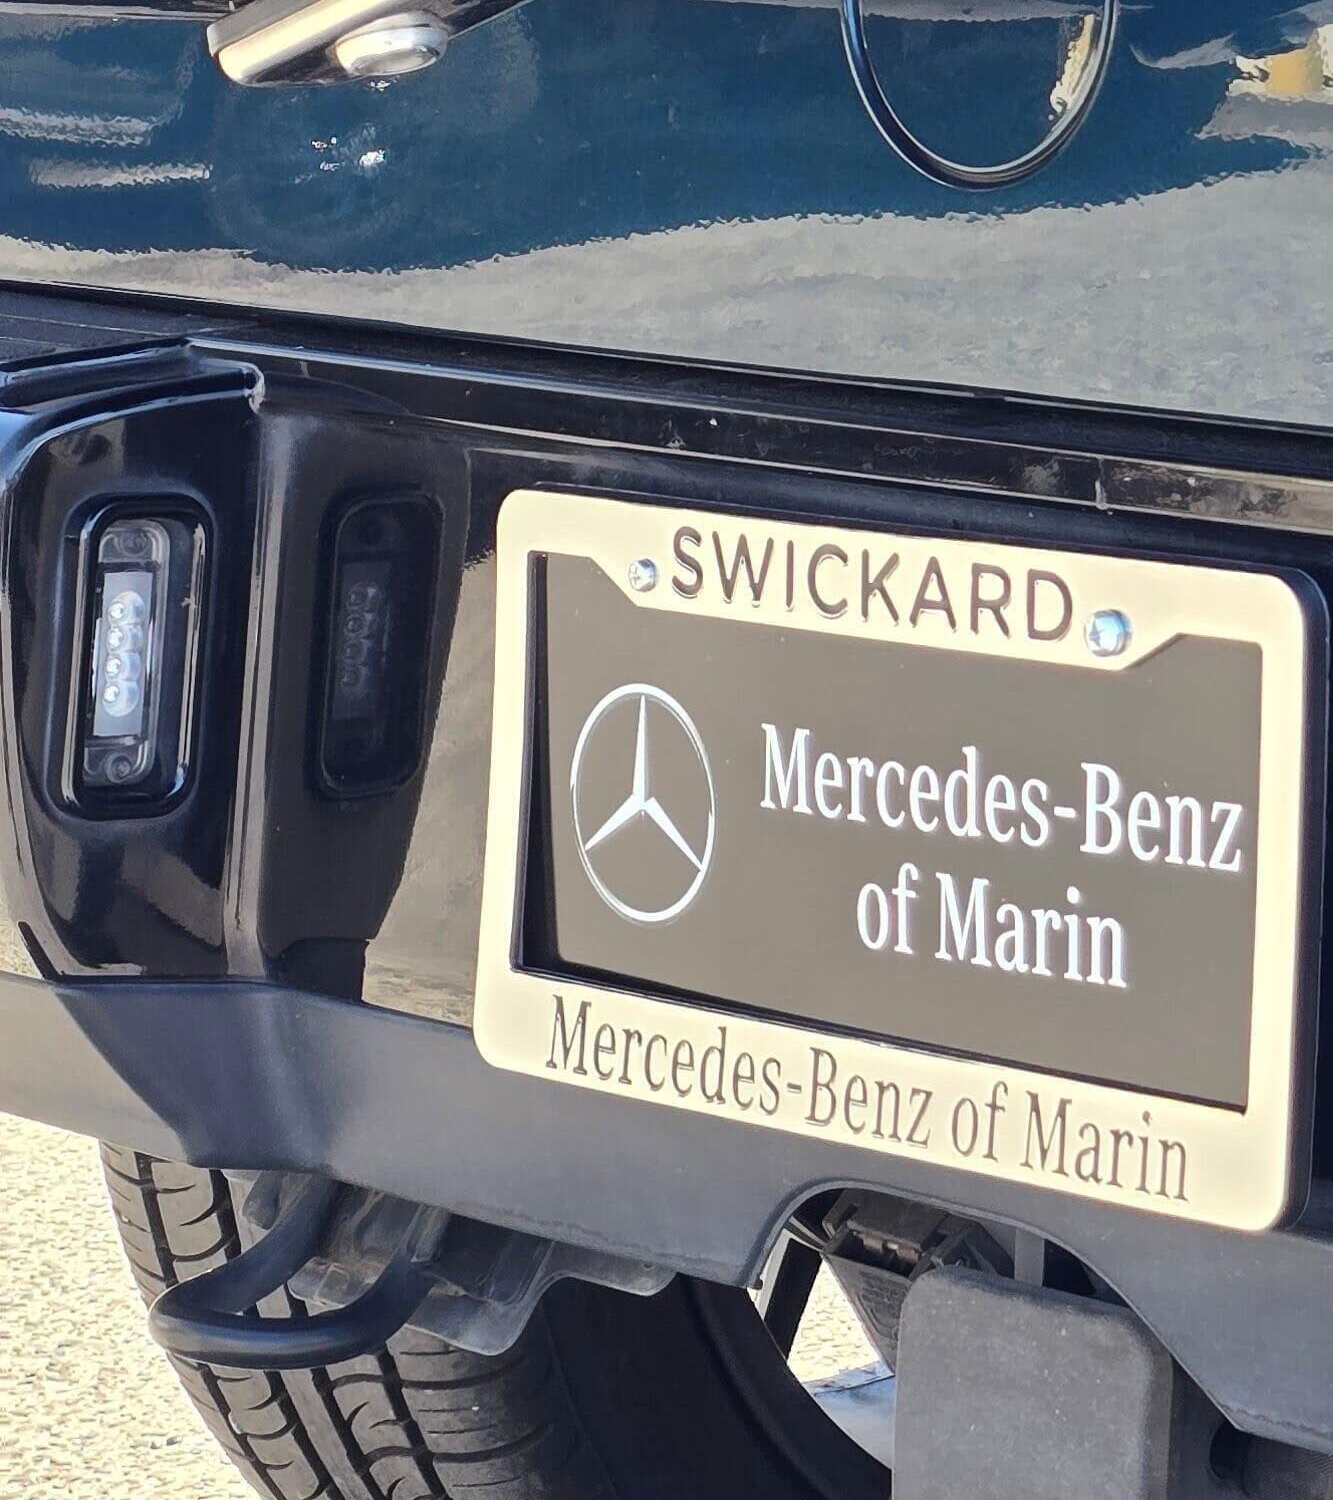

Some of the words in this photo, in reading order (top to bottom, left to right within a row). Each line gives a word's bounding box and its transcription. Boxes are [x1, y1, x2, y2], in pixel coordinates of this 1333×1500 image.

[672, 527, 1074, 642] SWICKARD
[760, 724, 1243, 872] Mercedes-Benz
[857, 863, 919, 954] of
[935, 872, 1127, 988] Marin
[545, 995, 934, 1147] Mercedes-Benz
[951, 1081, 1005, 1162] of
[1020, 1091, 1190, 1202] Marin
